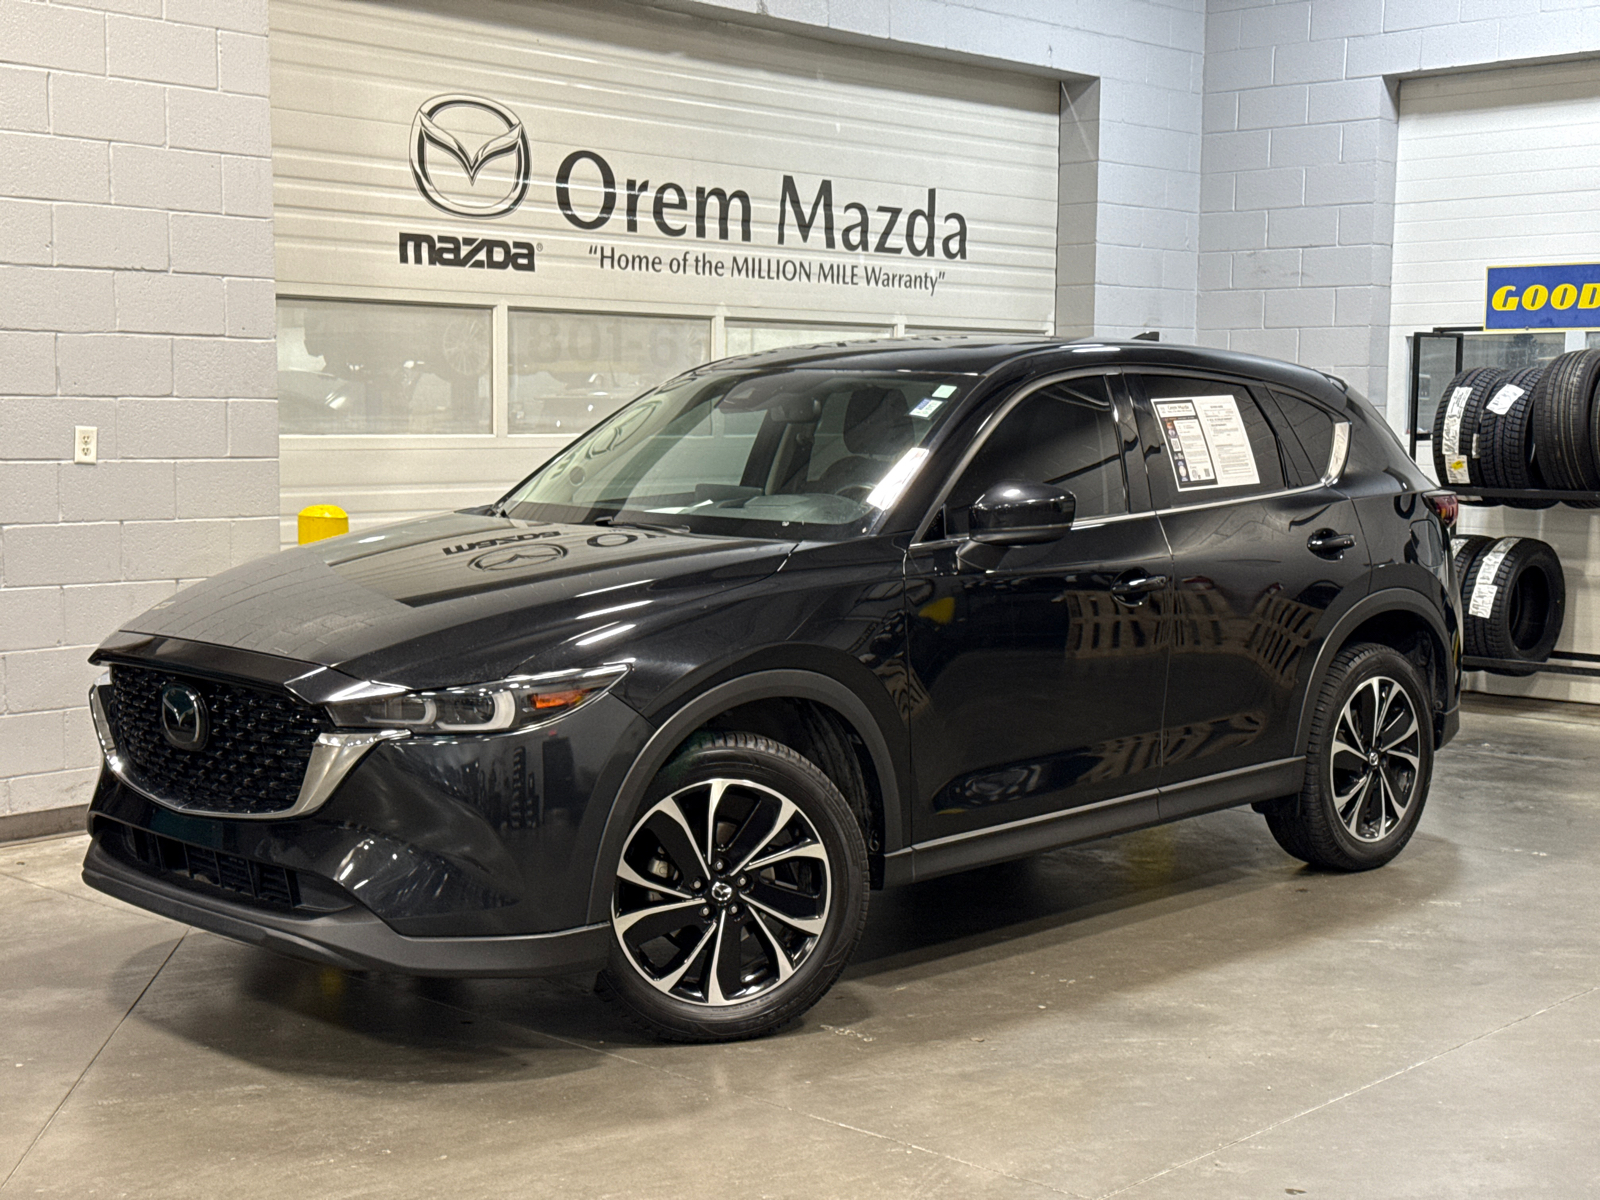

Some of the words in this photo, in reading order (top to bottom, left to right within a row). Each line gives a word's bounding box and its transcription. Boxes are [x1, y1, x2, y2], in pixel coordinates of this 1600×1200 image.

[556, 150, 751, 242] Orem
[777, 175, 967, 260] Mazda
[669, 250, 688, 275] of
[694, 254, 726, 277] the
[731, 257, 812, 283] MILLION
[817, 264, 861, 286] MILE
